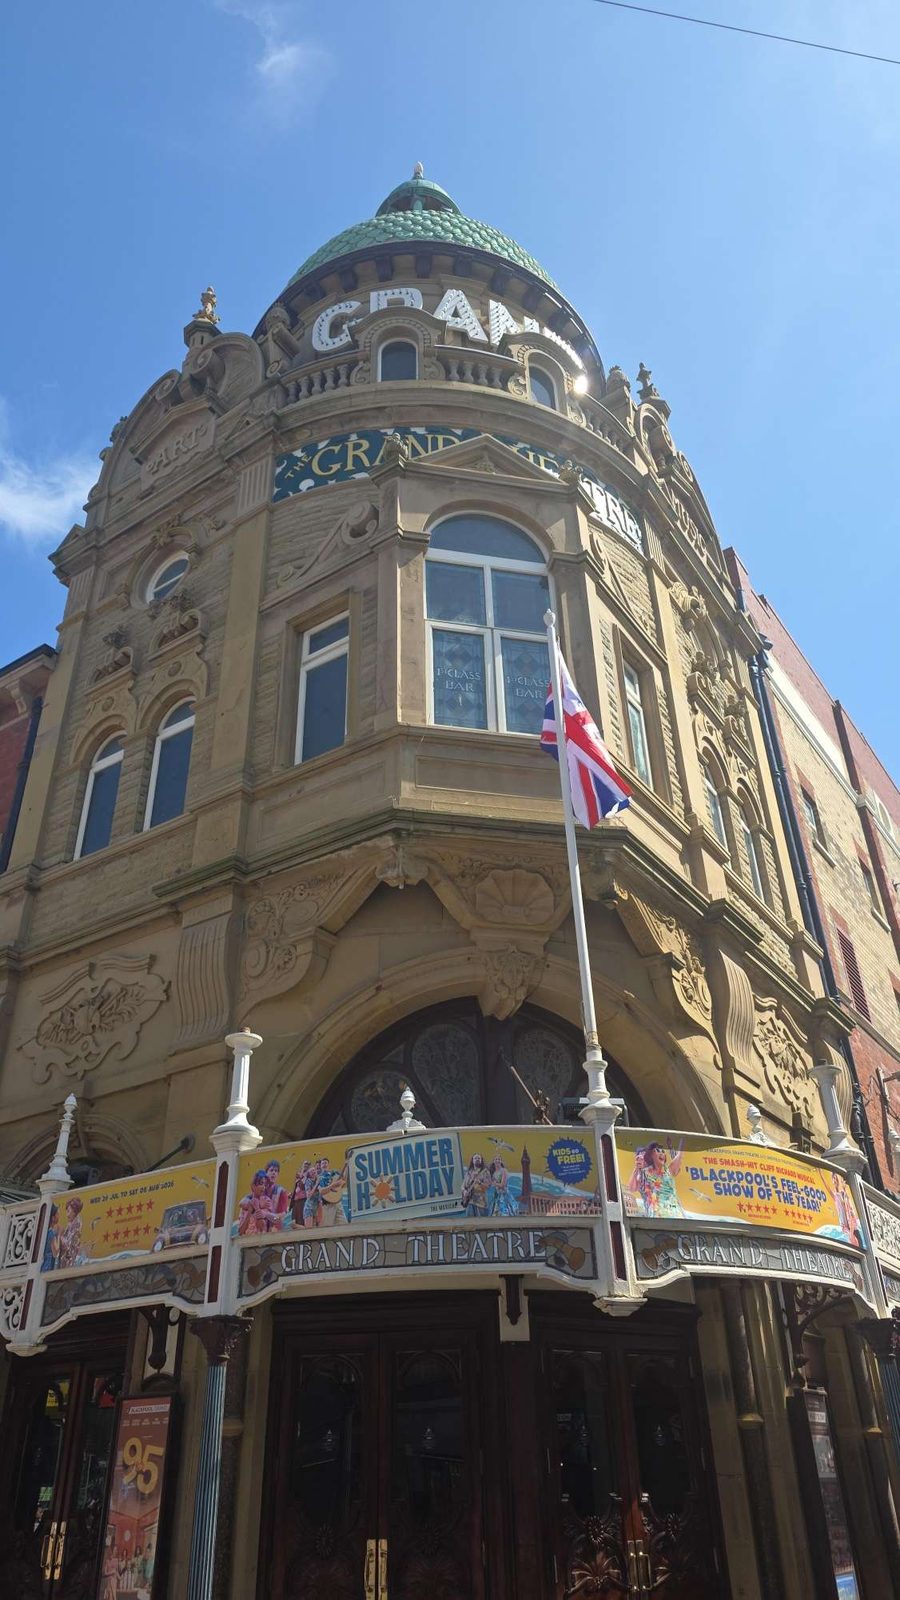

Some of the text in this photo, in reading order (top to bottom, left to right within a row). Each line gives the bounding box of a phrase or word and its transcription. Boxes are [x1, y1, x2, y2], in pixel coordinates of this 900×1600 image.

[284, 451, 312, 479] THE
[447, 668, 481, 680] CLASS
[445, 680, 475, 692] BAR
[515, 688, 545, 699] BAR
[354, 1138, 454, 1181] SUMMER
[552, 1148, 571, 1157] KIDS
[557, 1153, 585, 1165] FREE!
[703, 1156, 719, 1165] THE
[719, 1159, 759, 1170] SMASH-HIT
[760, 1163, 775, 1172] CLIFF
[685, 1166, 827, 1203] 'BLACKPOOL'S FEEL-GOOD
[713, 1182, 754, 1199] SHOW
[758, 1187, 772, 1201] OF
[775, 1190, 795, 1205] THE
[281, 1231, 546, 1272] GRAND THEATRE
[677, 1233, 852, 1281] GRAND THEATRE
